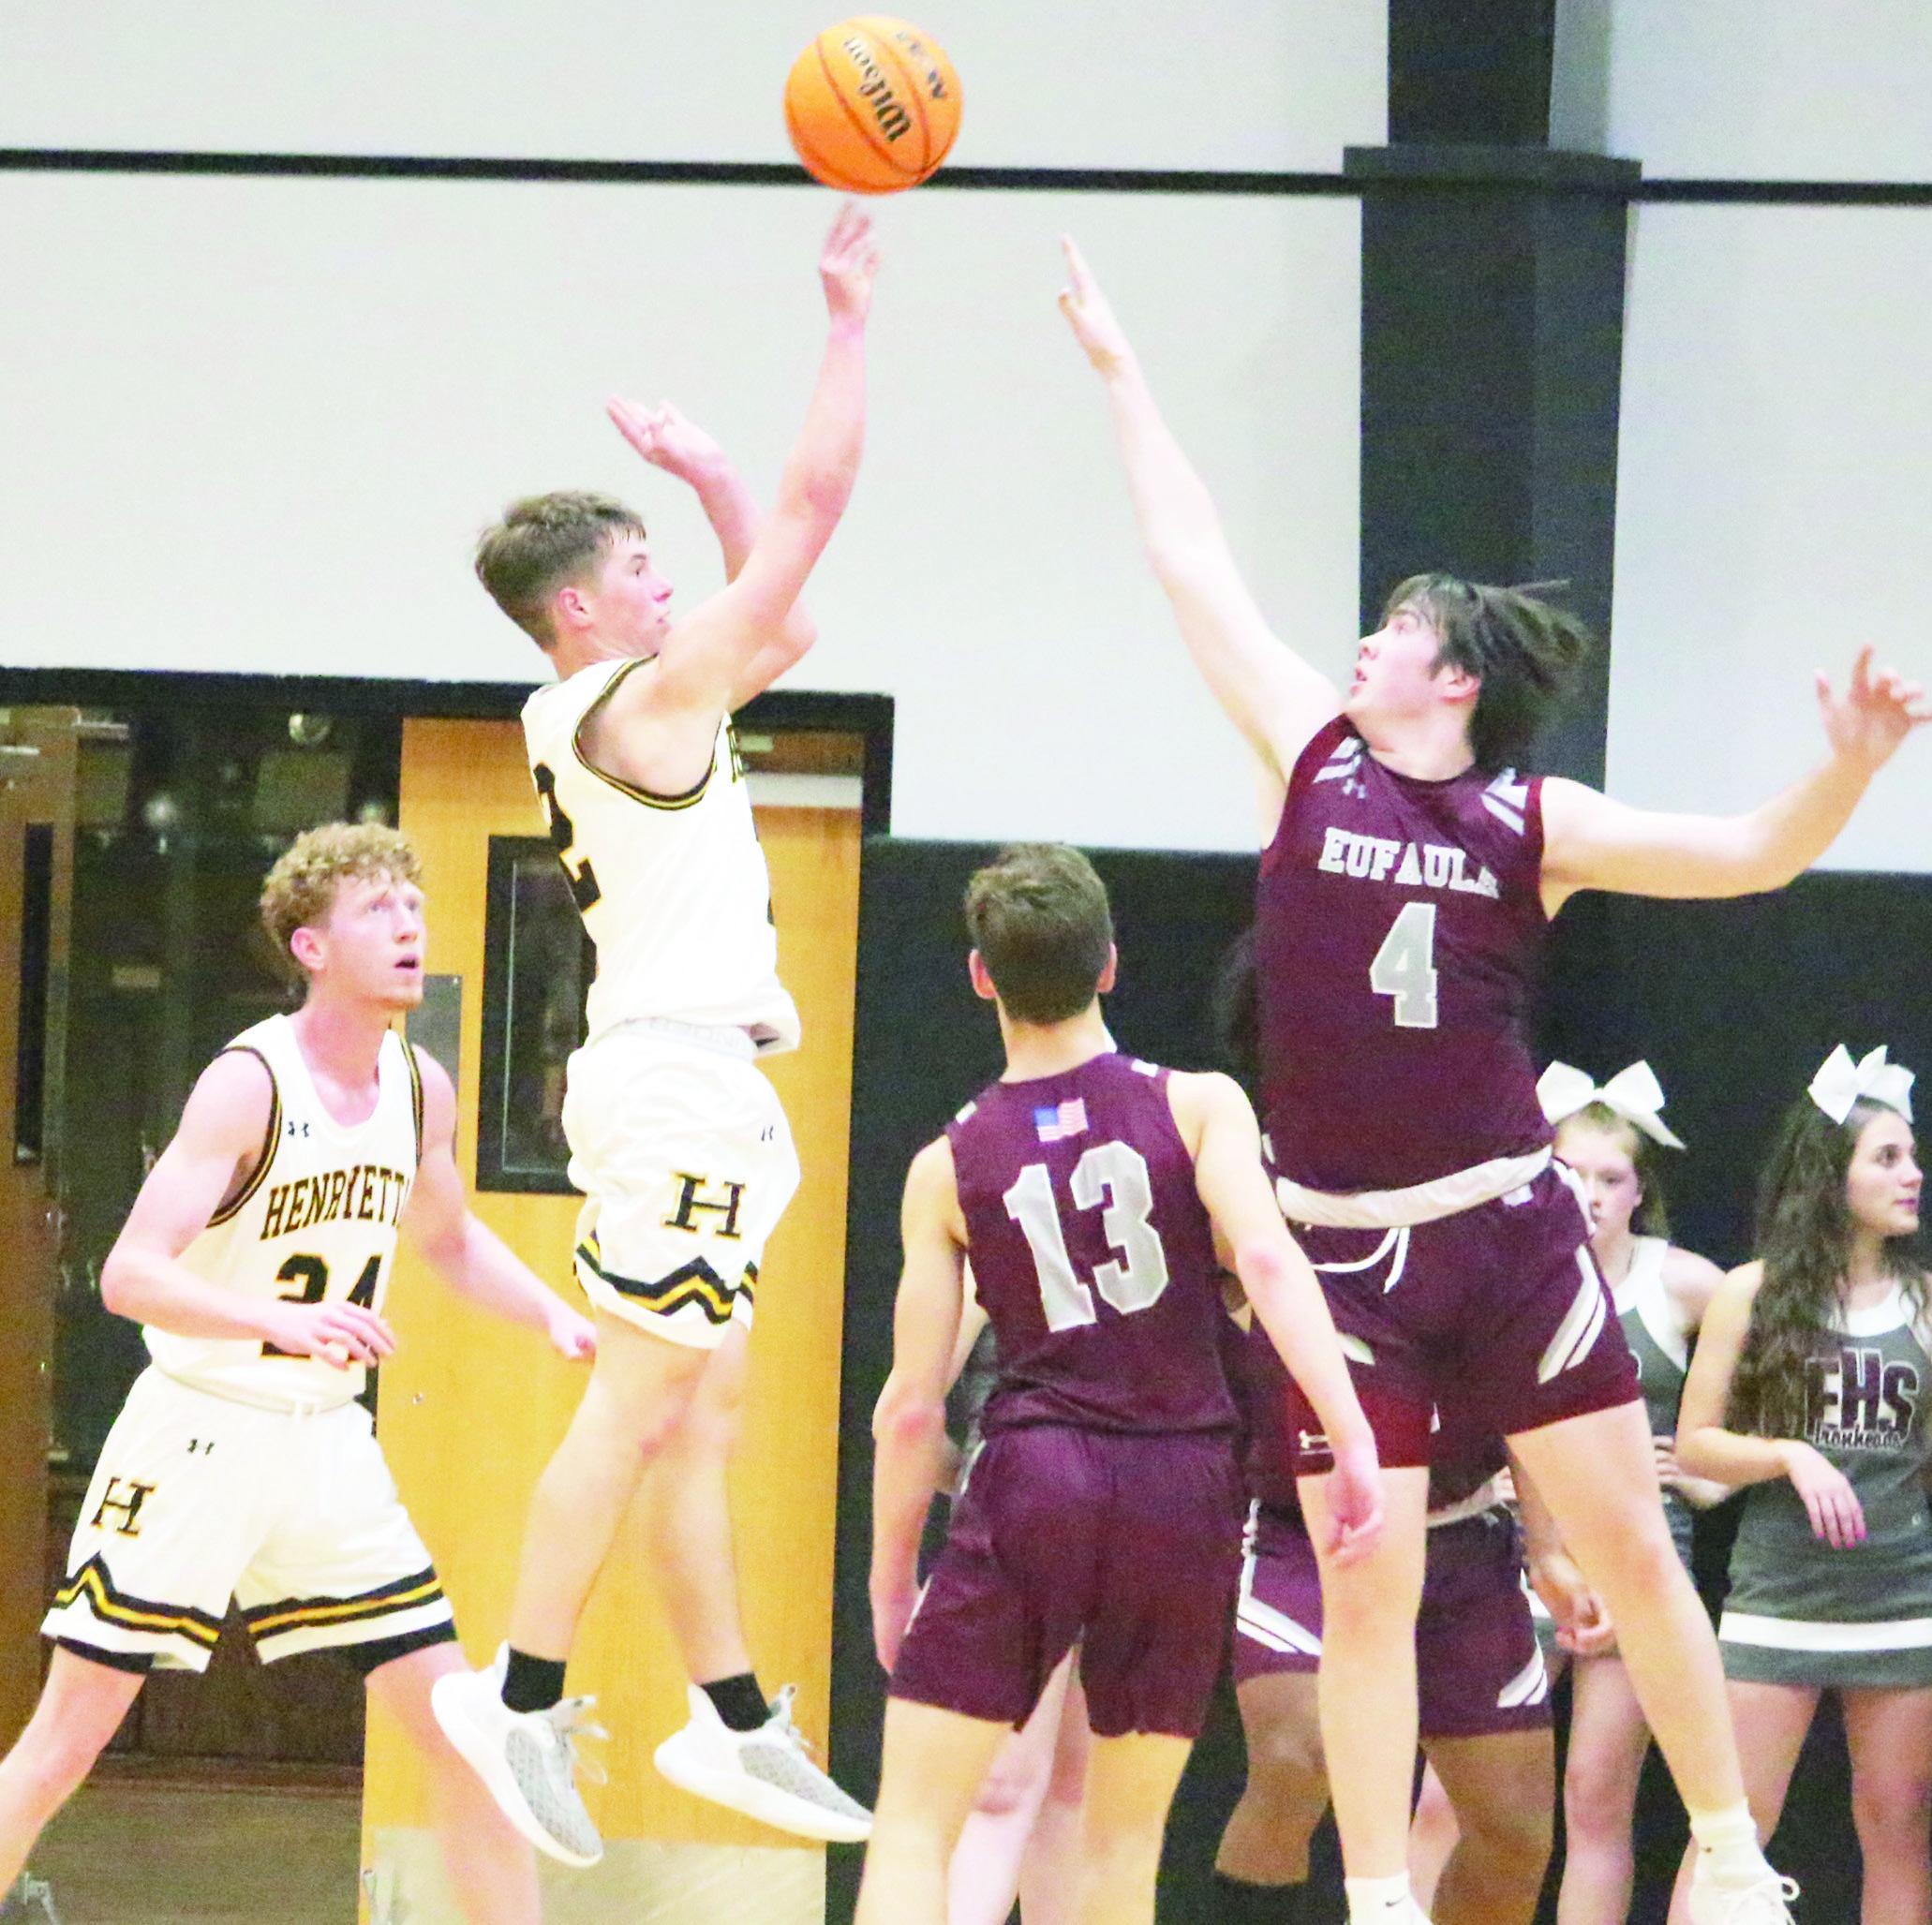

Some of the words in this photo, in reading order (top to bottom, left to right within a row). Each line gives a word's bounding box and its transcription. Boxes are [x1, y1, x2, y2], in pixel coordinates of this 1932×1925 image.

[842, 37, 912, 142] Wilson
[1369, 901, 1438, 1029] 4
[260, 1164, 409, 1240] HENRIETT
[664, 1171, 746, 1239] H
[1002, 1139, 1169, 1333] 13
[1804, 1345, 1919, 1443] EHS
[91, 1475, 156, 1537] H
